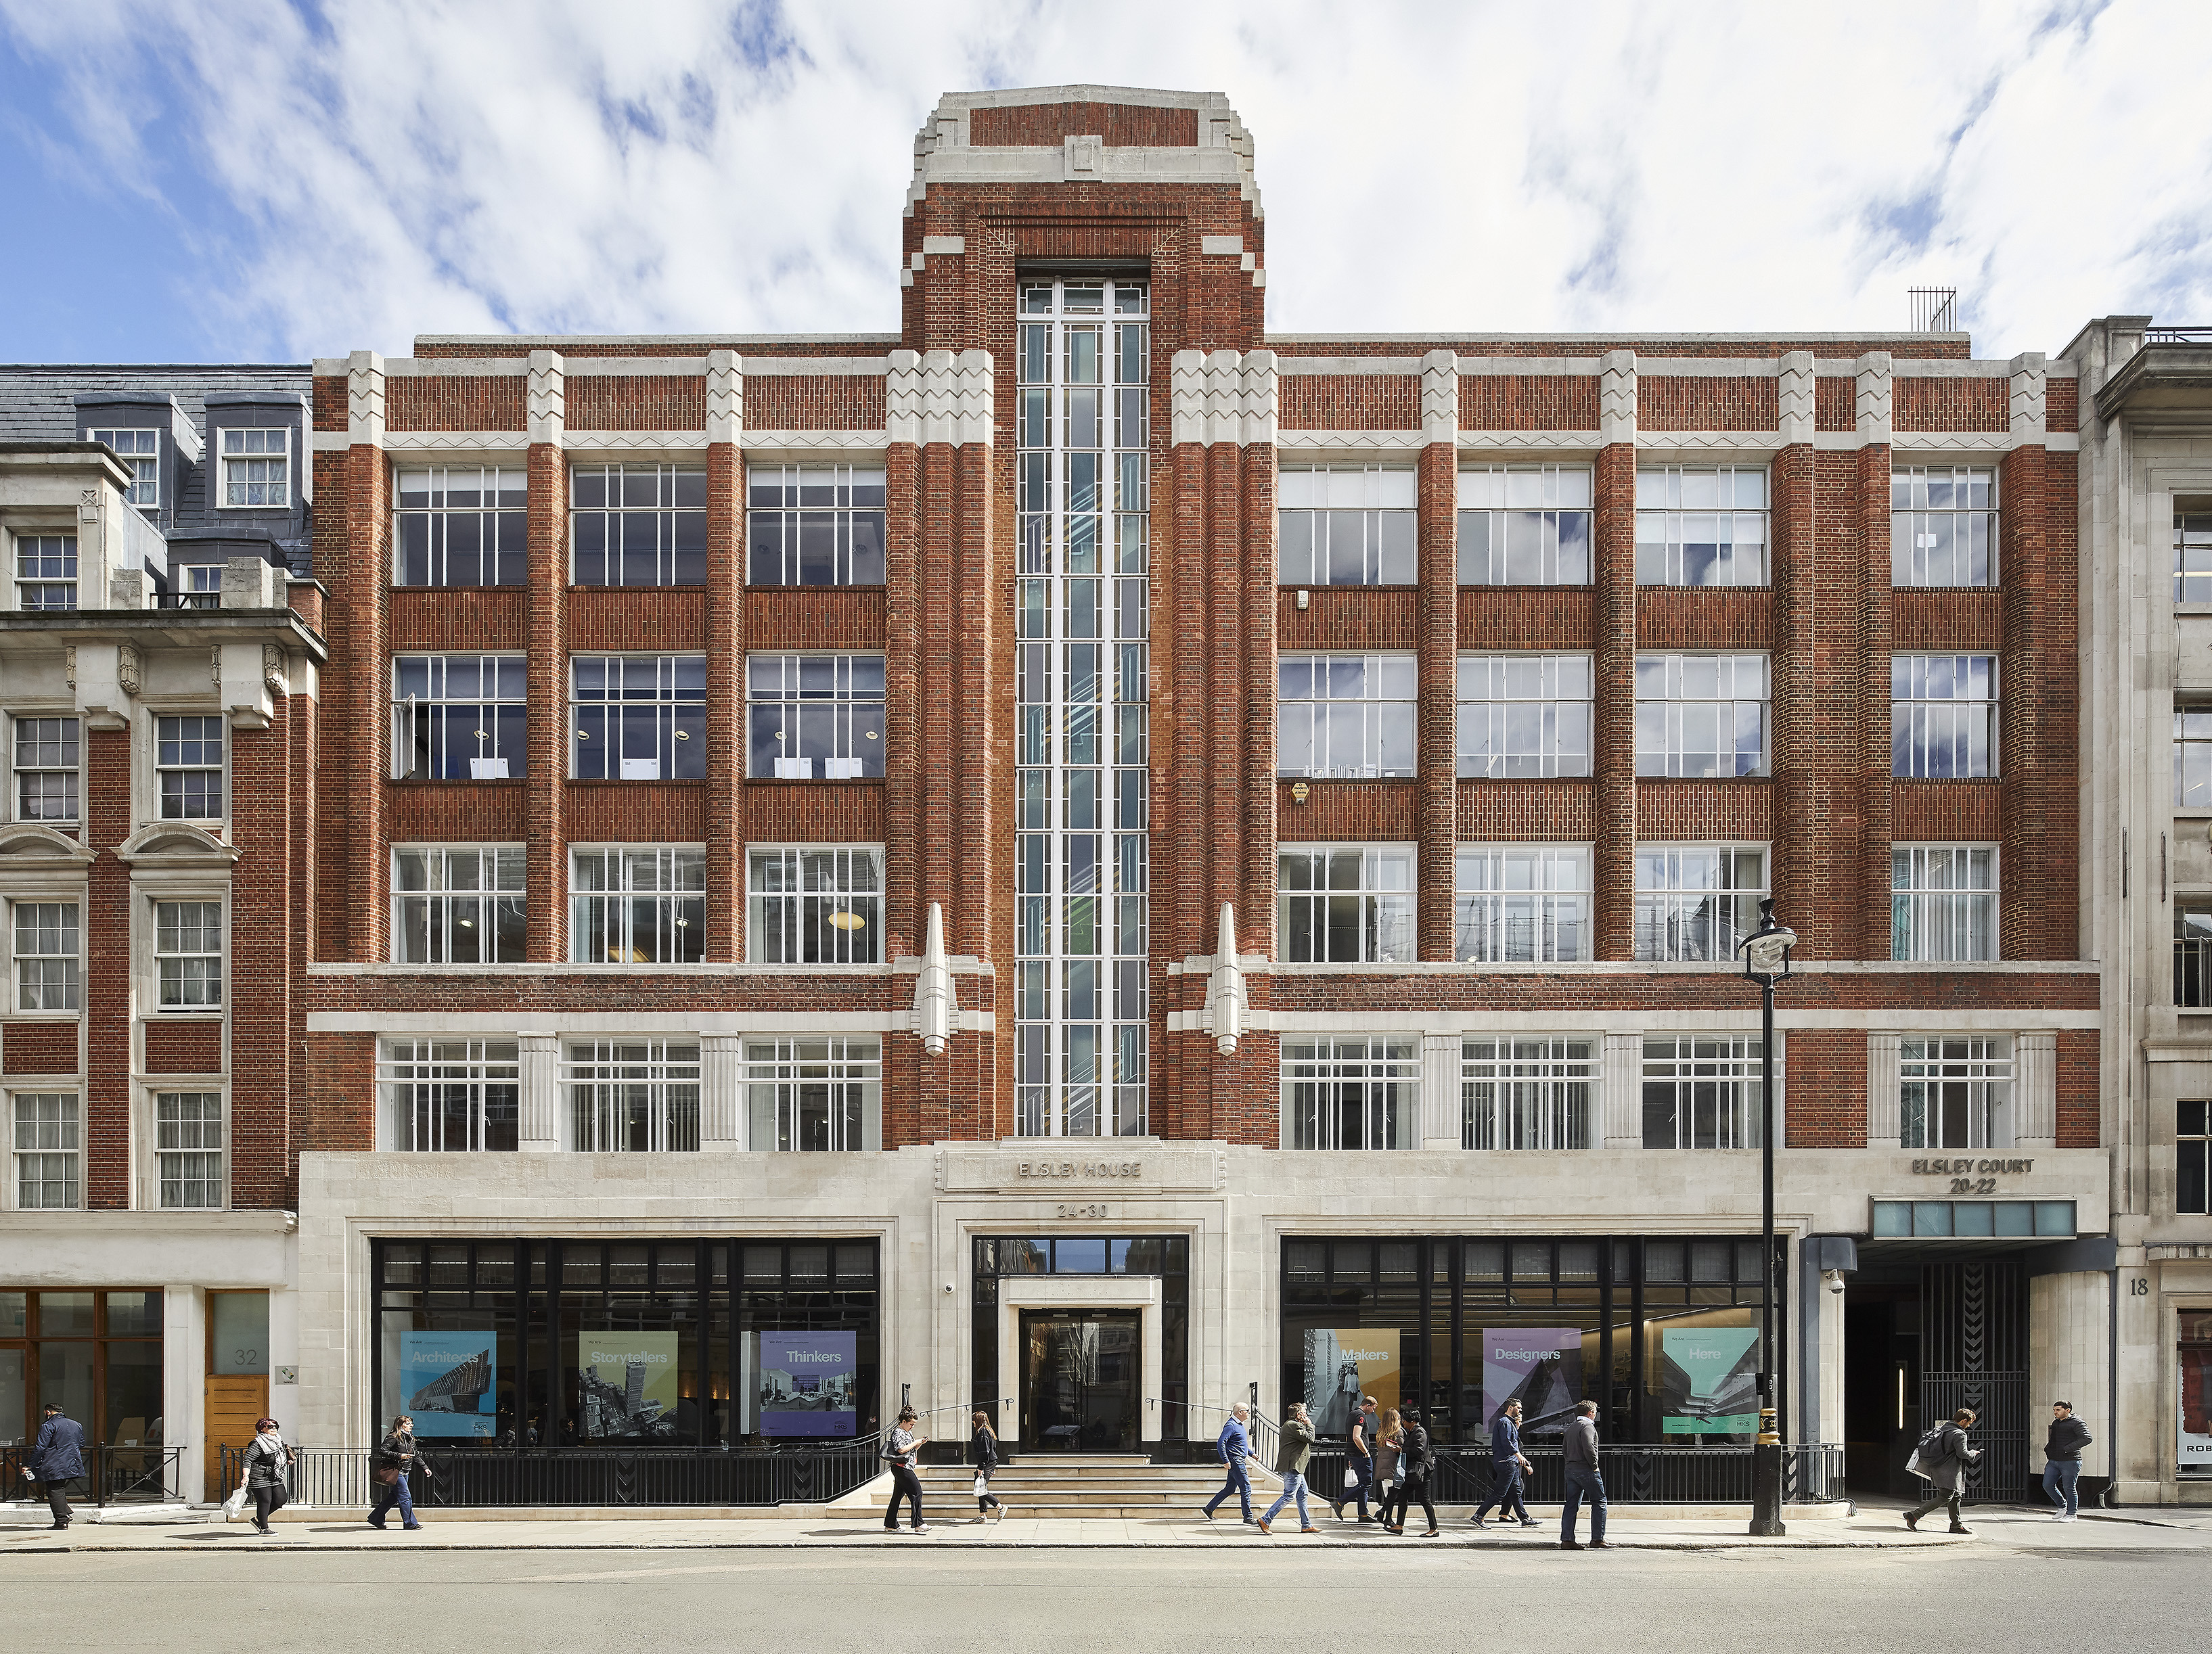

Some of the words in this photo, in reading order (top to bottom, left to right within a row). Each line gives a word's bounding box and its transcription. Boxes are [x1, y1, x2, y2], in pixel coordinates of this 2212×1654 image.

[1019, 1162, 1079, 1176] ELSLEY
[1085, 1162, 1142, 1176] HOUSE
[1912, 1159, 1975, 1173] ELSLEY
[1978, 1159, 2035, 1173] COURT
[1950, 1178, 1996, 1193] 20-22
[1058, 1203, 1108, 1217] 24-30
[2131, 1278, 2148, 1295] 18
[234, 1349, 257, 1365] 32
[412, 1351, 479, 1362] Architects
[591, 1351, 668, 1364] Storytellers
[786, 1350, 842, 1362] Thinkers
[1341, 1348, 1389, 1360] Makers
[1495, 1348, 1561, 1362] Designers
[1689, 1348, 1721, 1359] Here
